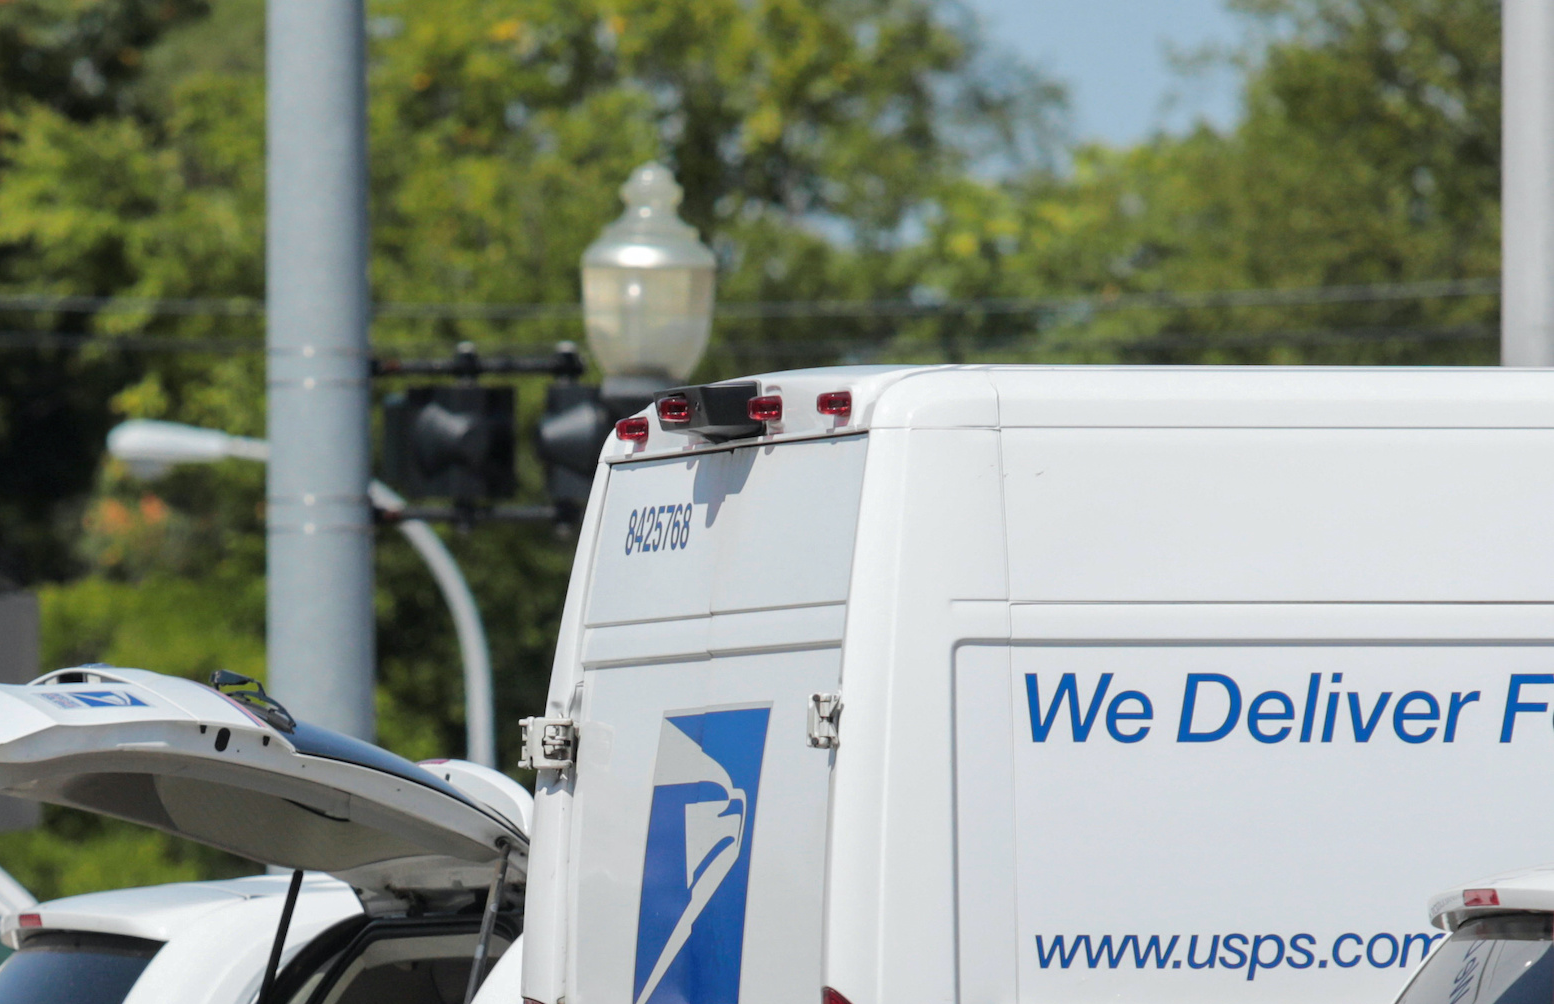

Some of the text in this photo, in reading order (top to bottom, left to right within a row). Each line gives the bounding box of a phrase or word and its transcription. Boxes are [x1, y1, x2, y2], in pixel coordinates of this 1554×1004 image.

[625, 503, 693, 556] 8425768
[1024, 672, 1554, 744] We Deliver F
